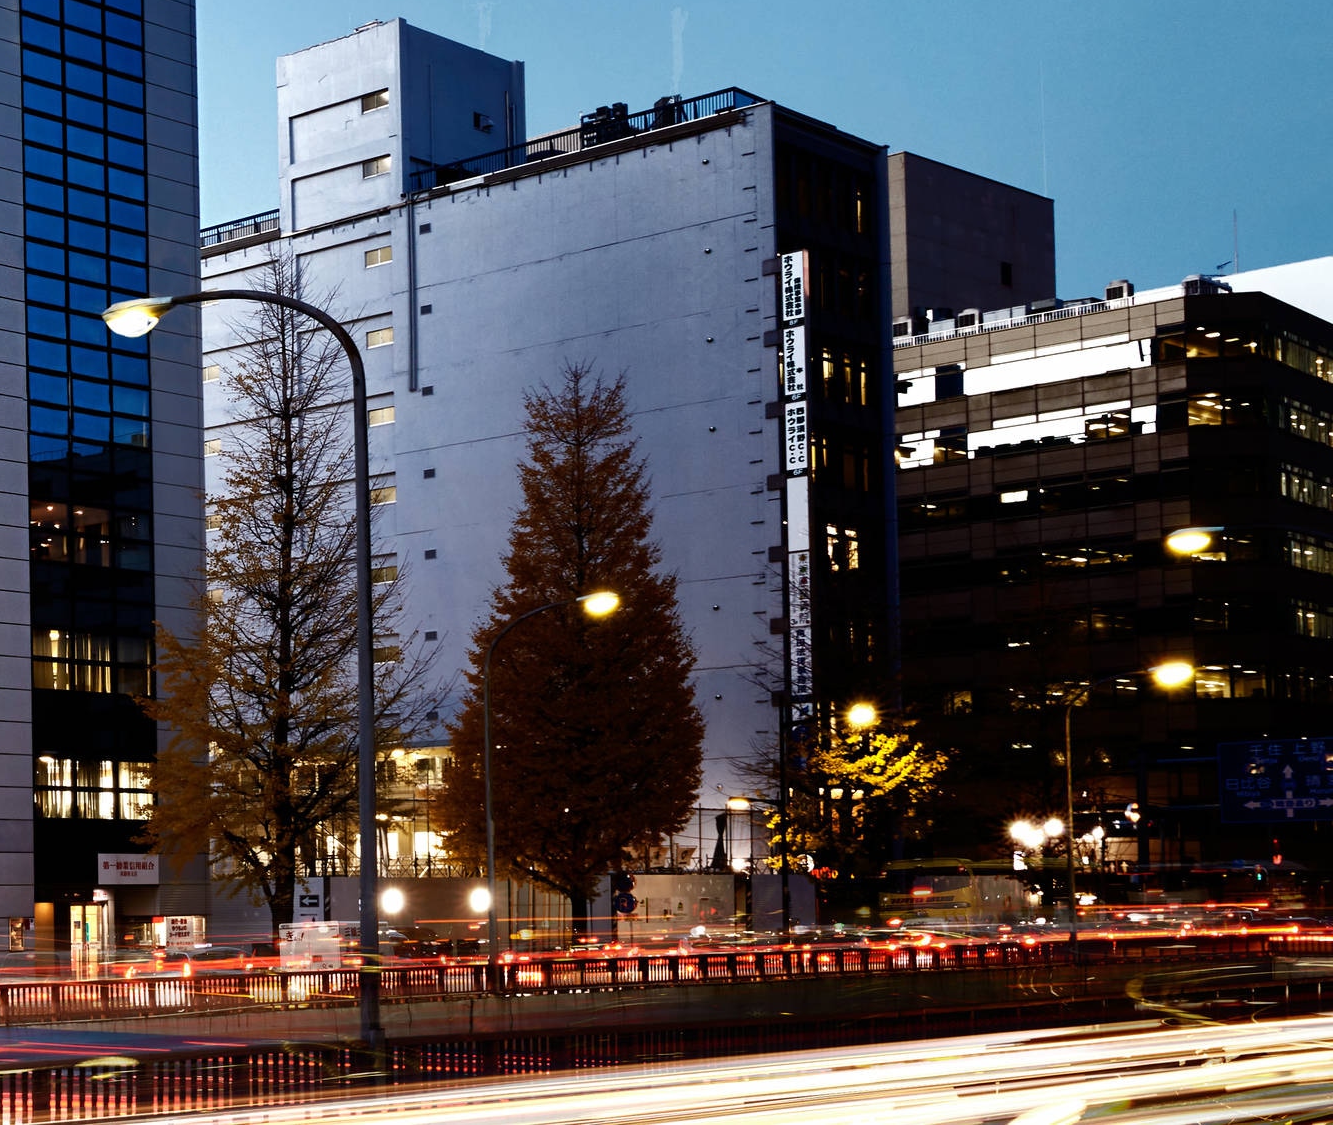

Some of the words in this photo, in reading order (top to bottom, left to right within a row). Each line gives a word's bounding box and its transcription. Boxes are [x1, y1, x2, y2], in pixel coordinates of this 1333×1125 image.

[784, 255, 794, 318] ホウライ株式会社
[786, 330, 796, 392] ホウライ株式会社
